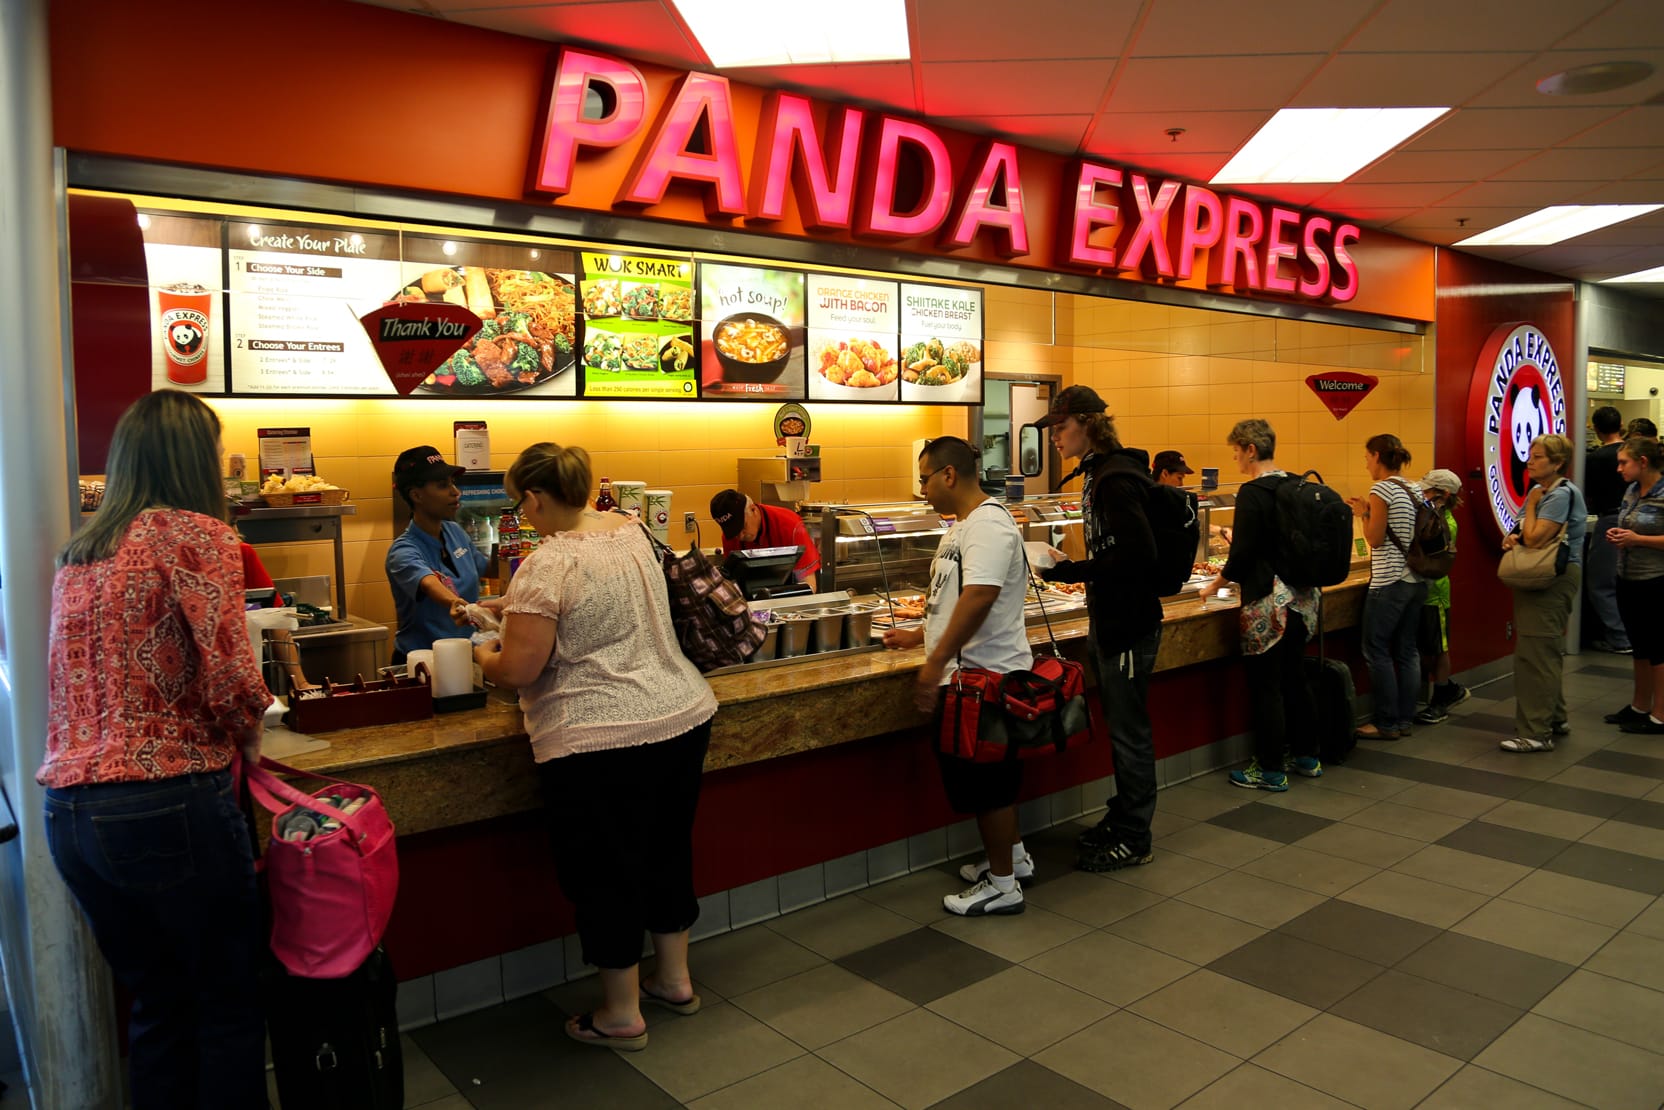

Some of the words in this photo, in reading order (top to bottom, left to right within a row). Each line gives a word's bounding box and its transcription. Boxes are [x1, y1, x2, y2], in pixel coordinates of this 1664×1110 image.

[528, 48, 1029, 256] PANDA
[1066, 160, 1360, 302] EXPRESS
[250, 234, 294, 249] Create
[296, 234, 330, 252] Your
[333, 237, 366, 254] Plate
[236, 261, 240, 271] 1
[251, 263, 282, 273] Choose
[285, 265, 305, 275] Your
[307, 267, 325, 276] Side
[594, 257, 632, 273] WOK
[636, 261, 684, 278] SMART
[747, 290, 787, 314] soup!
[817, 287, 853, 299] ORANGE
[854, 290, 889, 302] CHICKEN
[819, 297, 848, 310] WITH
[850, 299, 887, 313] BACON
[906, 295, 950, 310] SHIITAKE
[952, 299, 976, 312] KALE
[830, 313, 847, 322] Feed
[912, 308, 943, 318] CHICKEN
[944, 310, 973, 321] BREAST
[383, 317, 432, 337] Thank
[435, 317, 464, 338] You
[236, 338, 243, 348] 2
[252, 340, 285, 350] Choose
[286, 341, 306, 350] Your
[308, 342, 341, 352] Entrees
[1320, 380, 1364, 391] Welcome
[1488, 335, 1524, 434] PANDA
[1525, 331, 1566, 434] EXPRESS
[1488, 464, 1516, 533] GOURME
